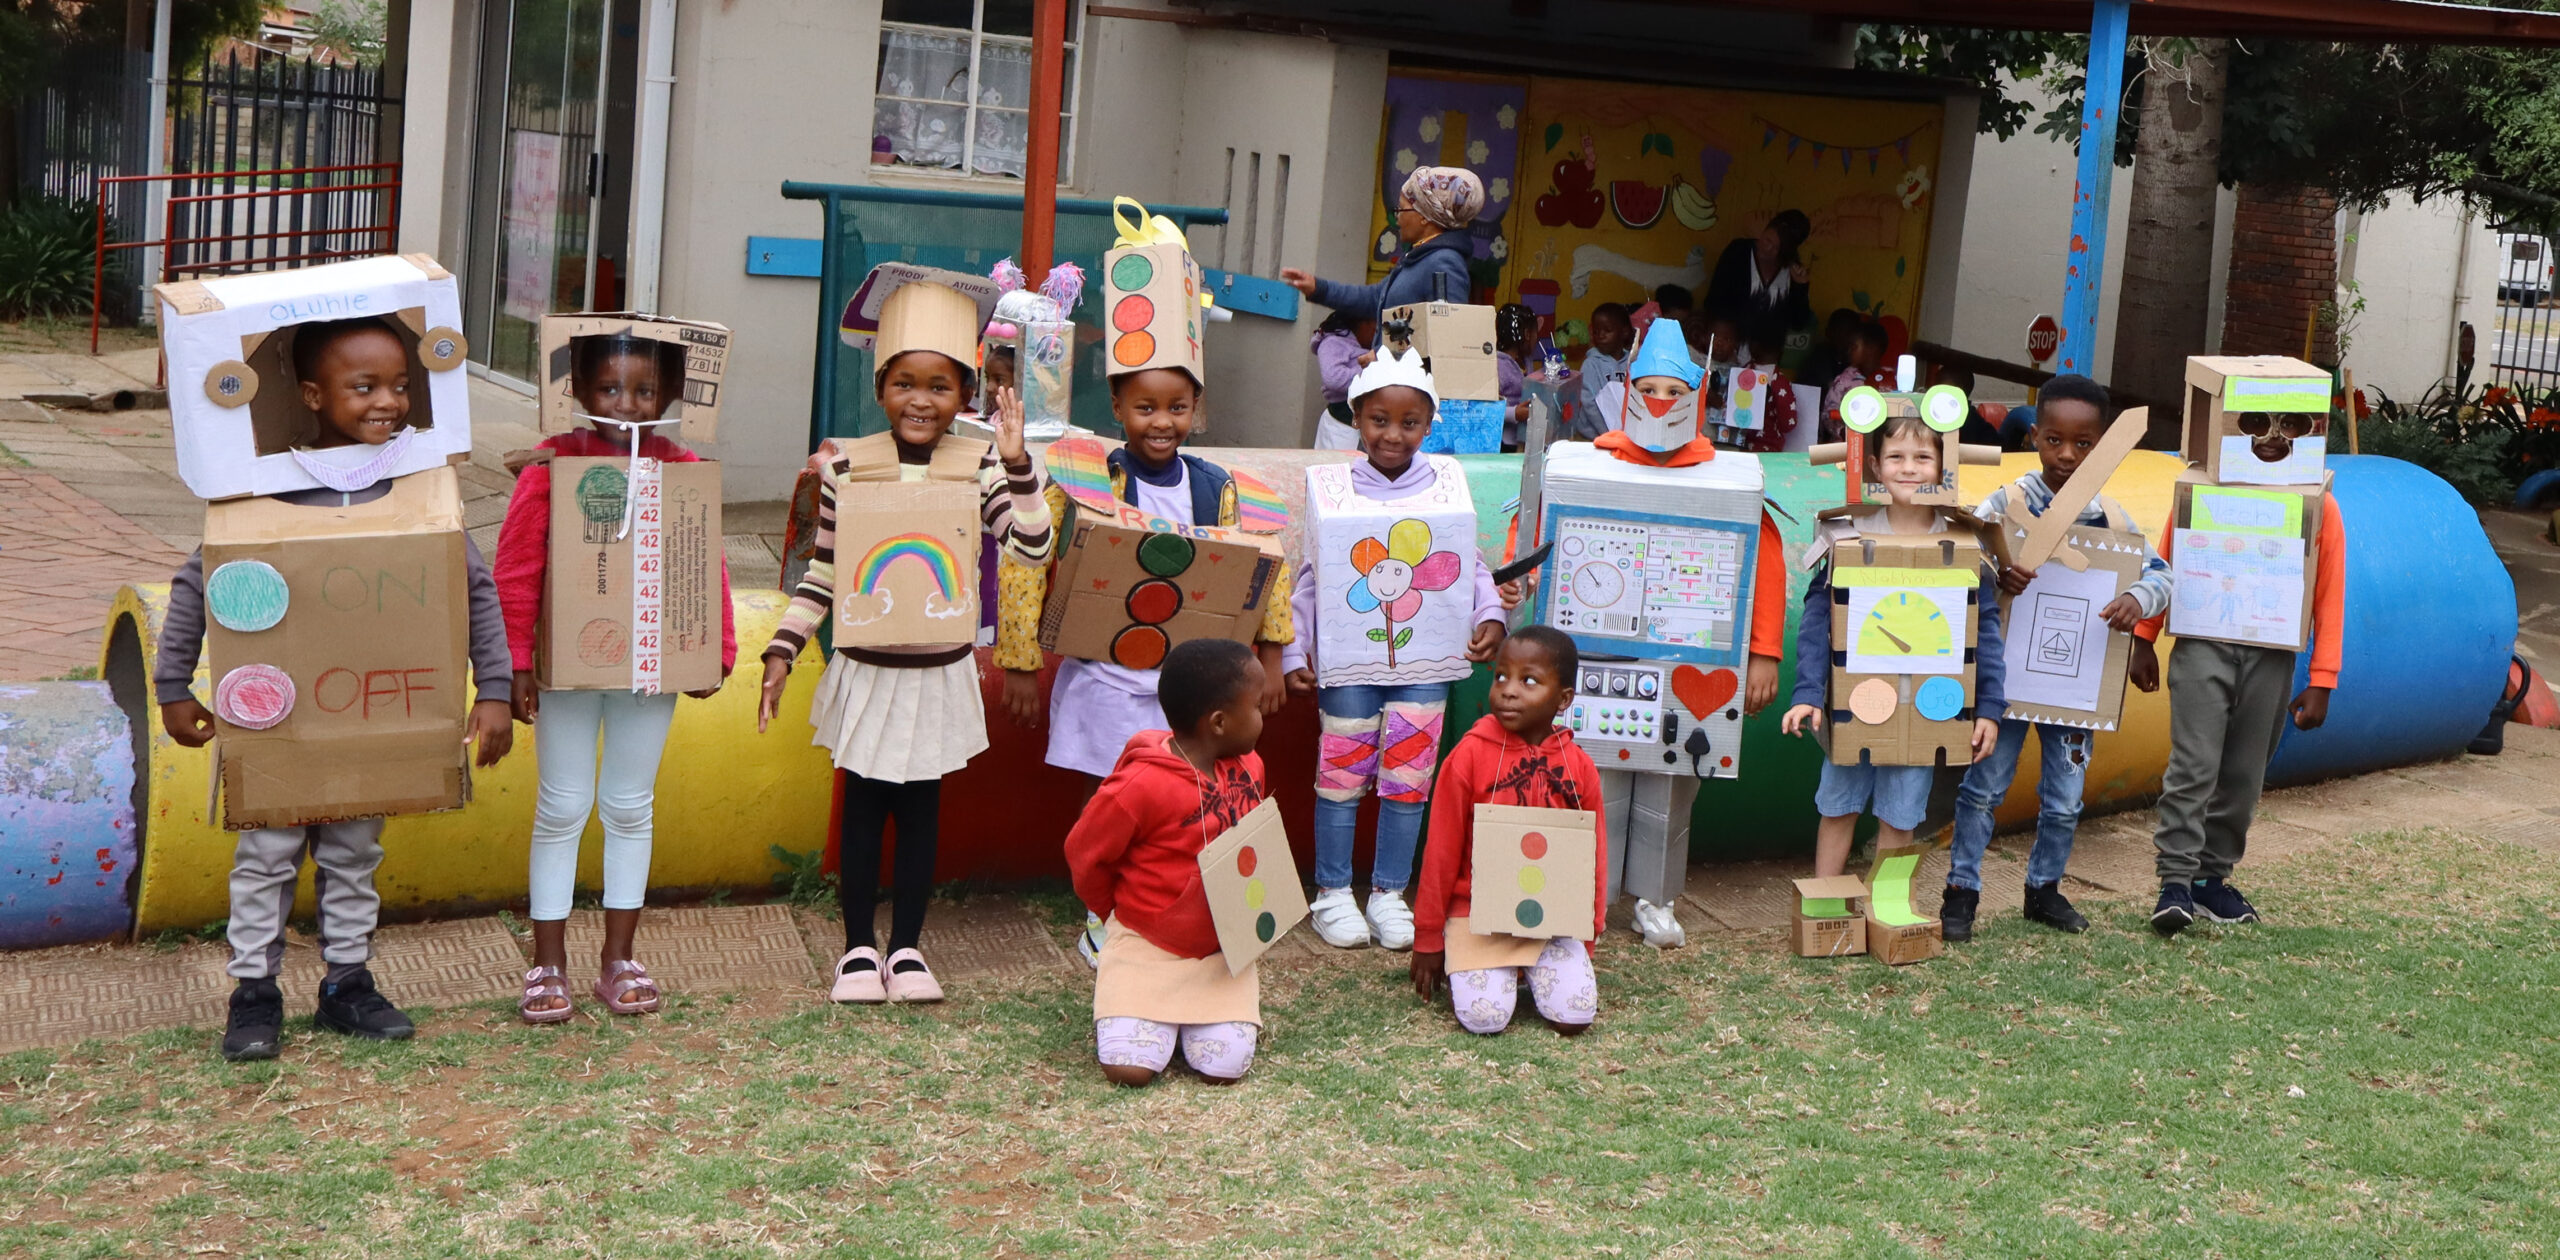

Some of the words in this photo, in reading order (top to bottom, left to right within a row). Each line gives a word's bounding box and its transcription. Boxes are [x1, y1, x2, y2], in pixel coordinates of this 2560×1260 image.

[953, 281, 991, 295] ATURES
[681, 330, 692, 338] 12
[702, 333, 718, 343] 150
[2030, 331, 2057, 349] STOP
[640, 509, 658, 522] 42
[1119, 507, 1229, 541] ROBOT
[640, 534, 658, 548] 42
[640, 559, 658, 573] 42
[598, 552, 607, 595] 20011729
[322, 565, 427, 613] ON
[640, 585, 658, 599] 42
[640, 610, 658, 623] 42
[639, 635, 658, 648] 42
[639, 659, 657, 672] 42
